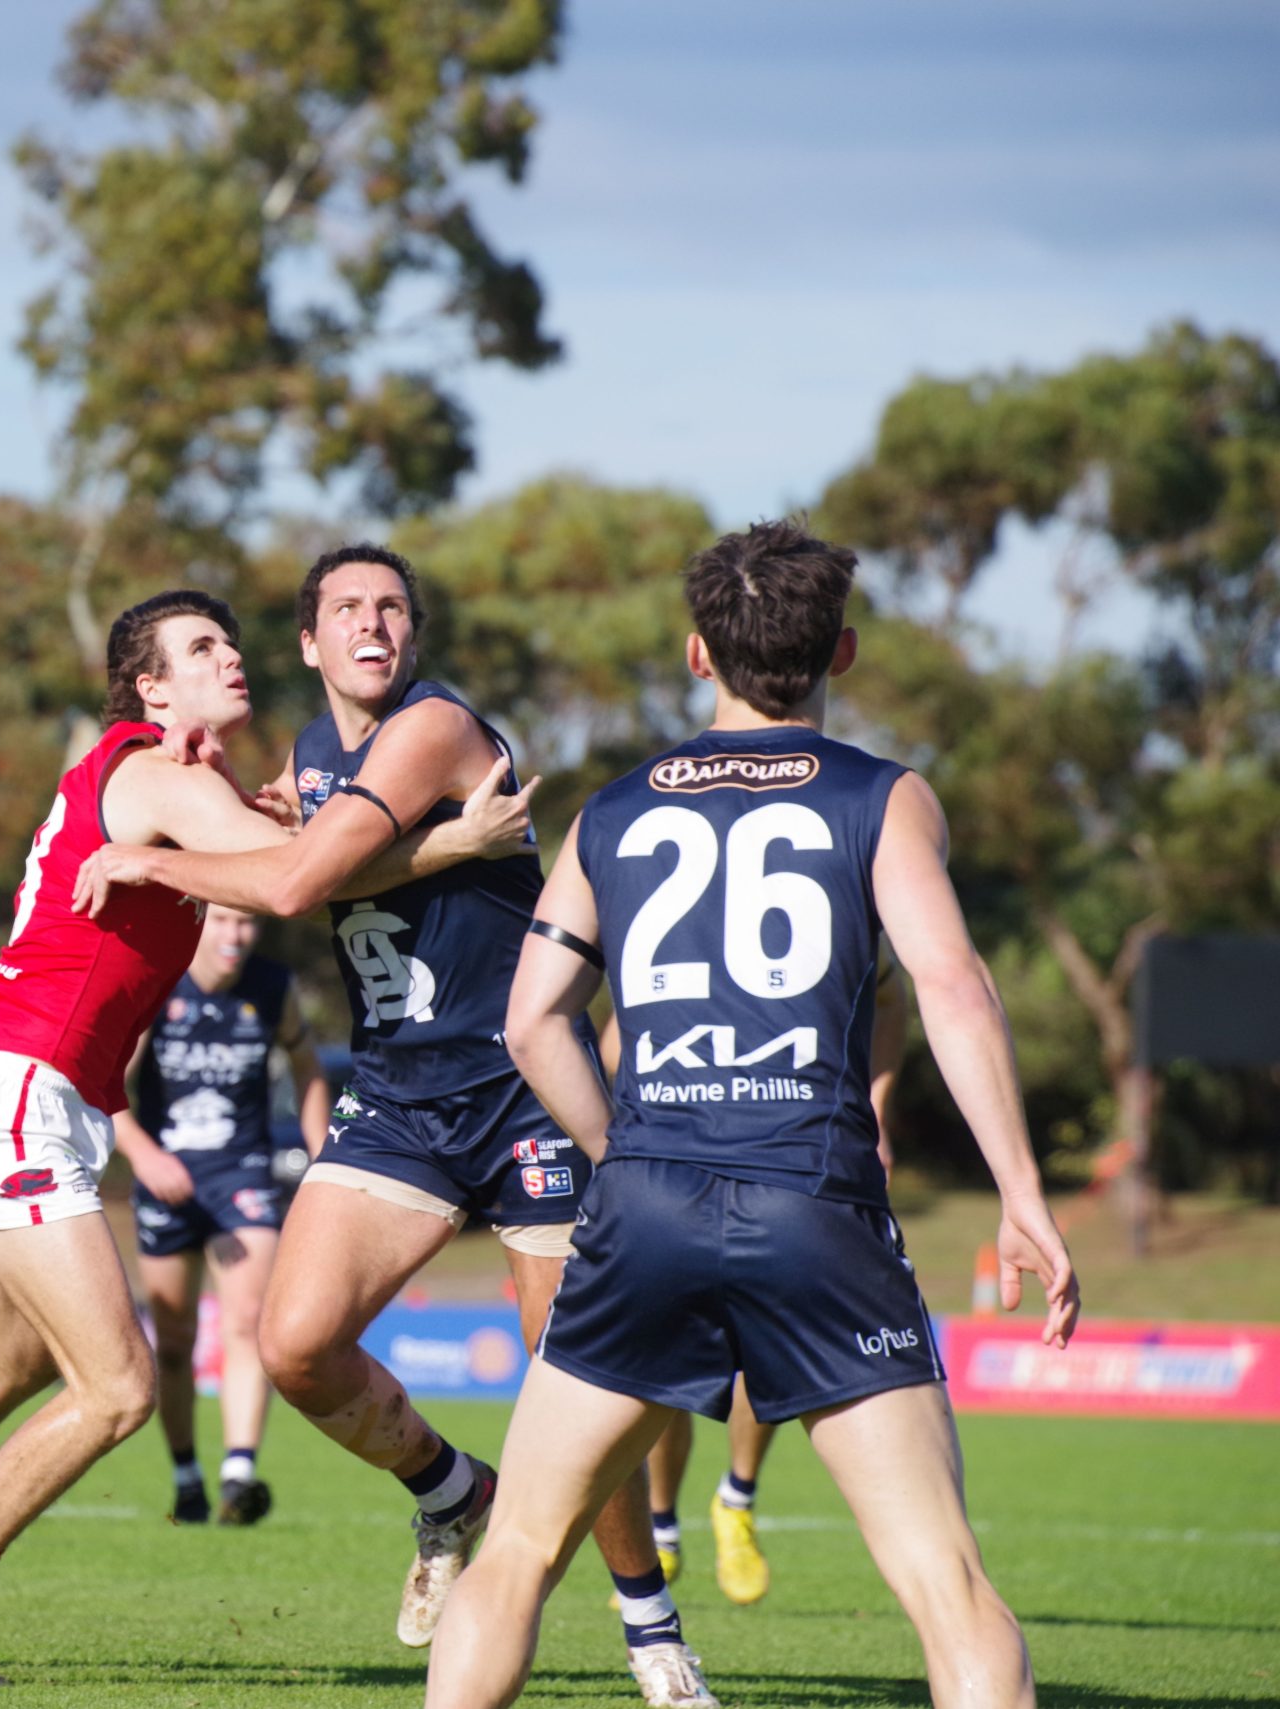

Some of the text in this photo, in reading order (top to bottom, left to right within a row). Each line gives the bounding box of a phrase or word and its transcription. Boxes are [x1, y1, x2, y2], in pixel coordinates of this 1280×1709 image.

[654, 759, 810, 788] BALFOURS
[616, 802, 834, 1009] 26
[636, 1024, 818, 1075] KIA
[639, 1077, 814, 1103] Wayne Phillis
[537, 1138, 573, 1151] SEAFORD
[539, 1150, 556, 1160] RISE
[856, 1327, 919, 1358] loftus
